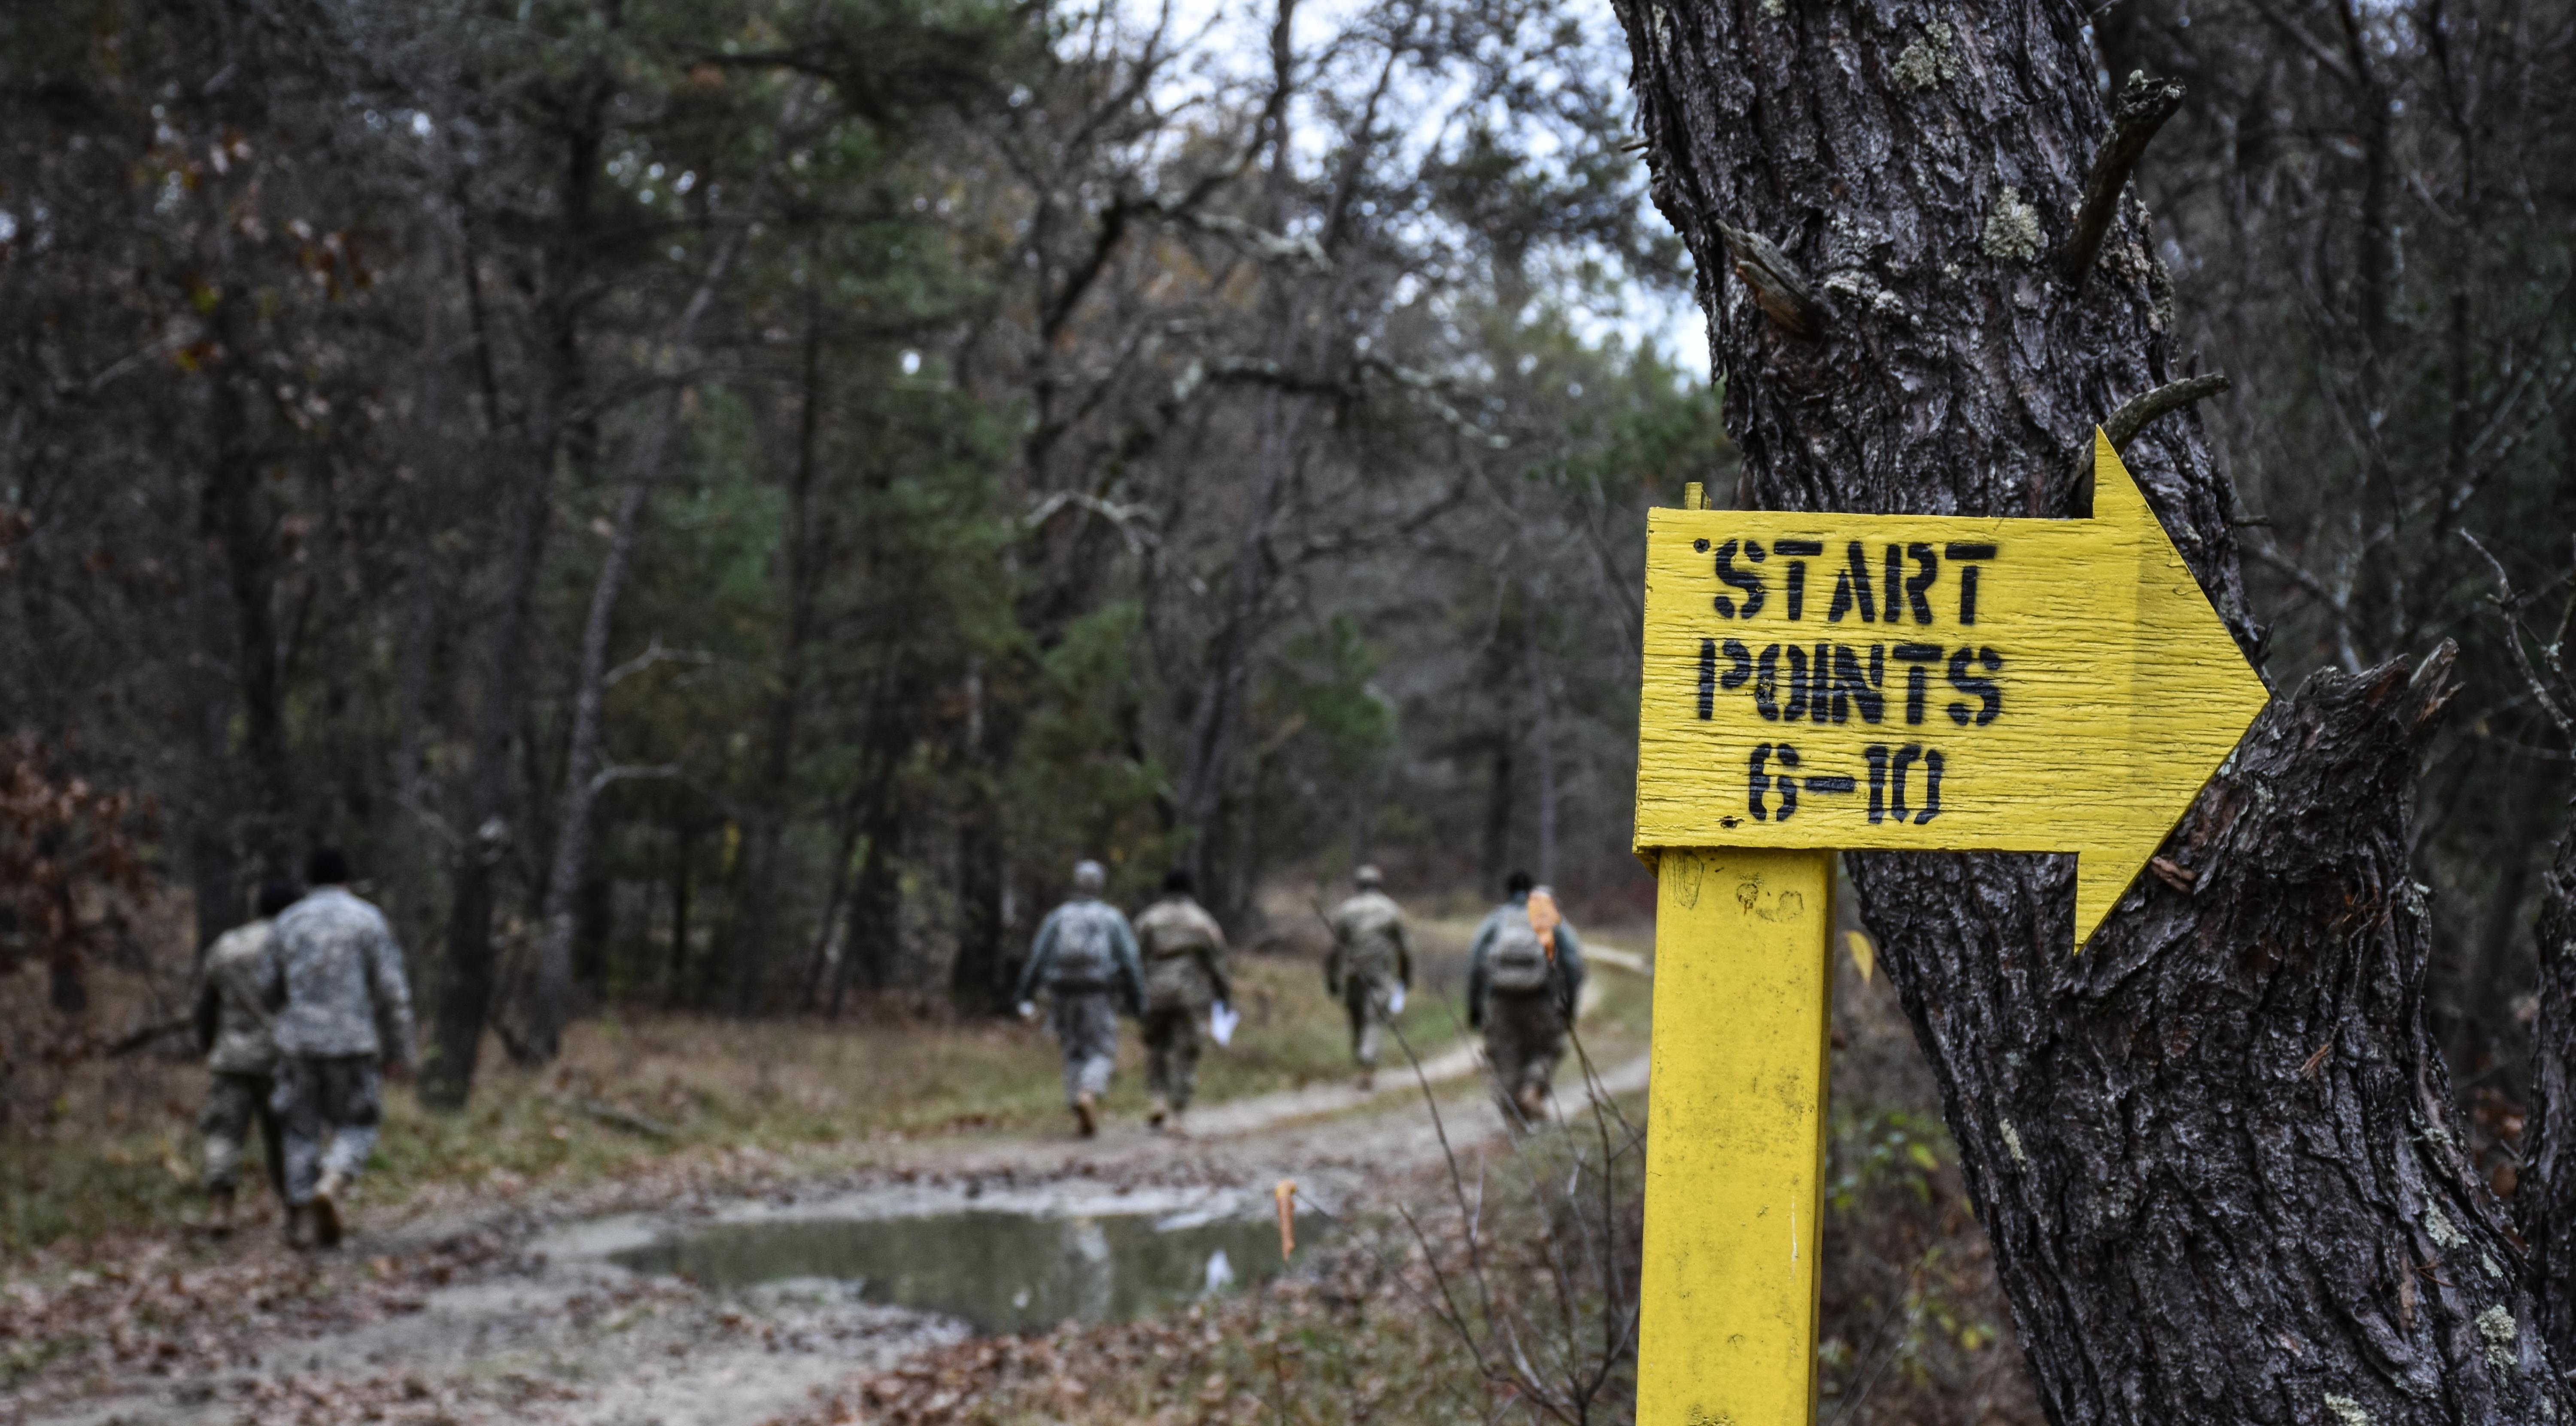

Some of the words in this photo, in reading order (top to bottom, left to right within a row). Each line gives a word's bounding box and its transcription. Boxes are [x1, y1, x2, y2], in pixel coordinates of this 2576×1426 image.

[1713, 538, 1999, 626] START
[1697, 638, 2004, 727] POINTS
[1747, 743, 1946, 825] 6-10
